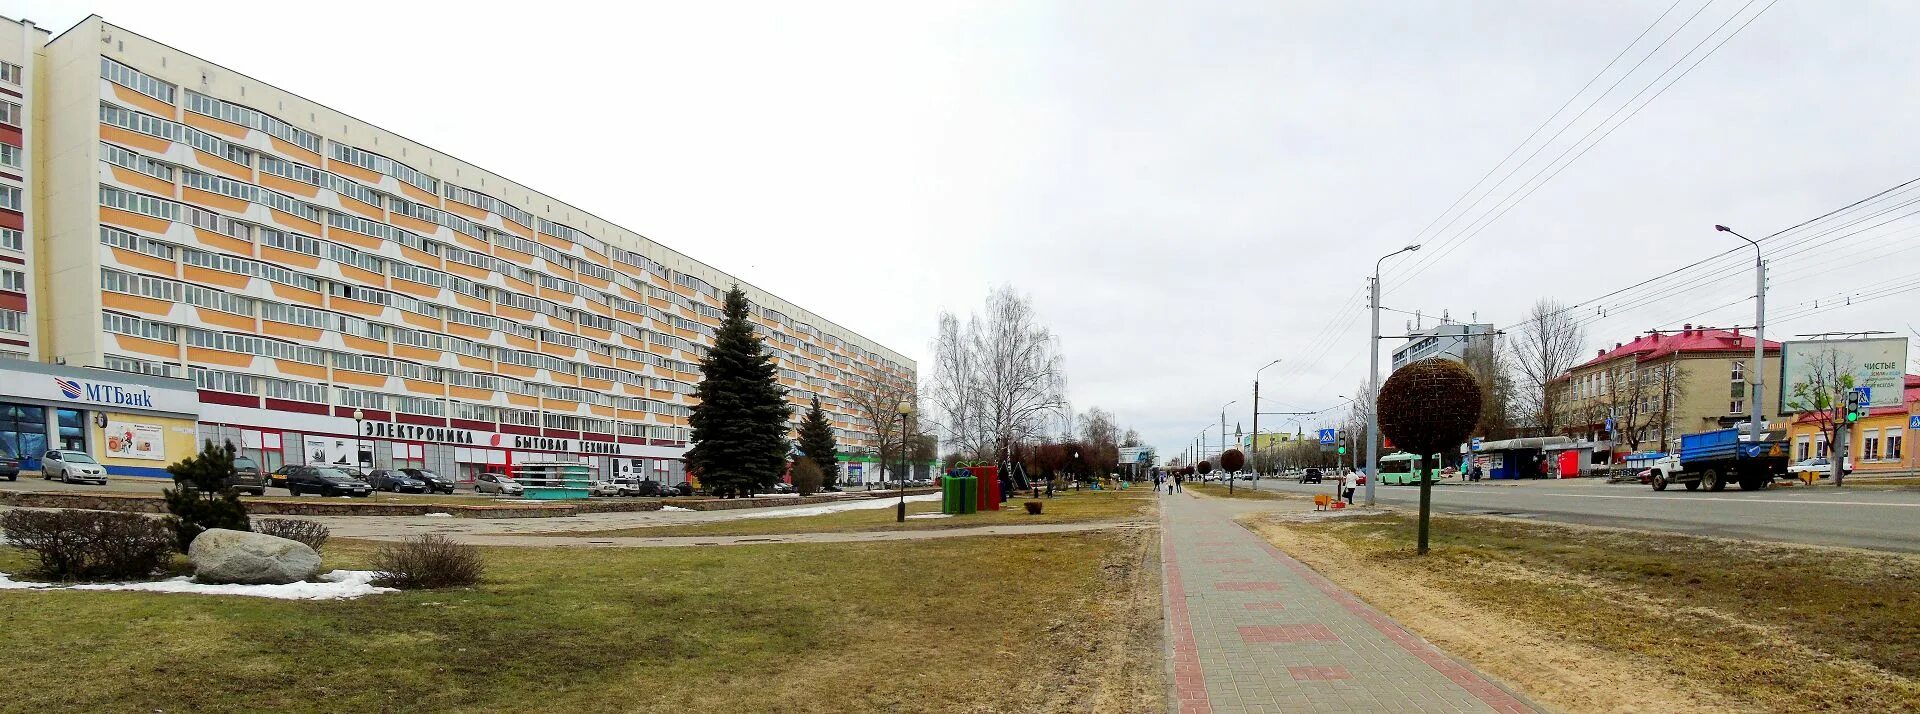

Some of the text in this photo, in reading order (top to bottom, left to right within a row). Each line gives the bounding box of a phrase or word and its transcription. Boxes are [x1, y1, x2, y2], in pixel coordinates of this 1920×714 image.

[1864, 362, 1896, 370] ЧИСТЫЕ
[85, 383, 152, 407] МТБанк
[366, 422, 473, 444] ЭЛЕКТРОНИКА
[515, 436, 621, 454] БЫТОВАЯ ТЕХНИКА
